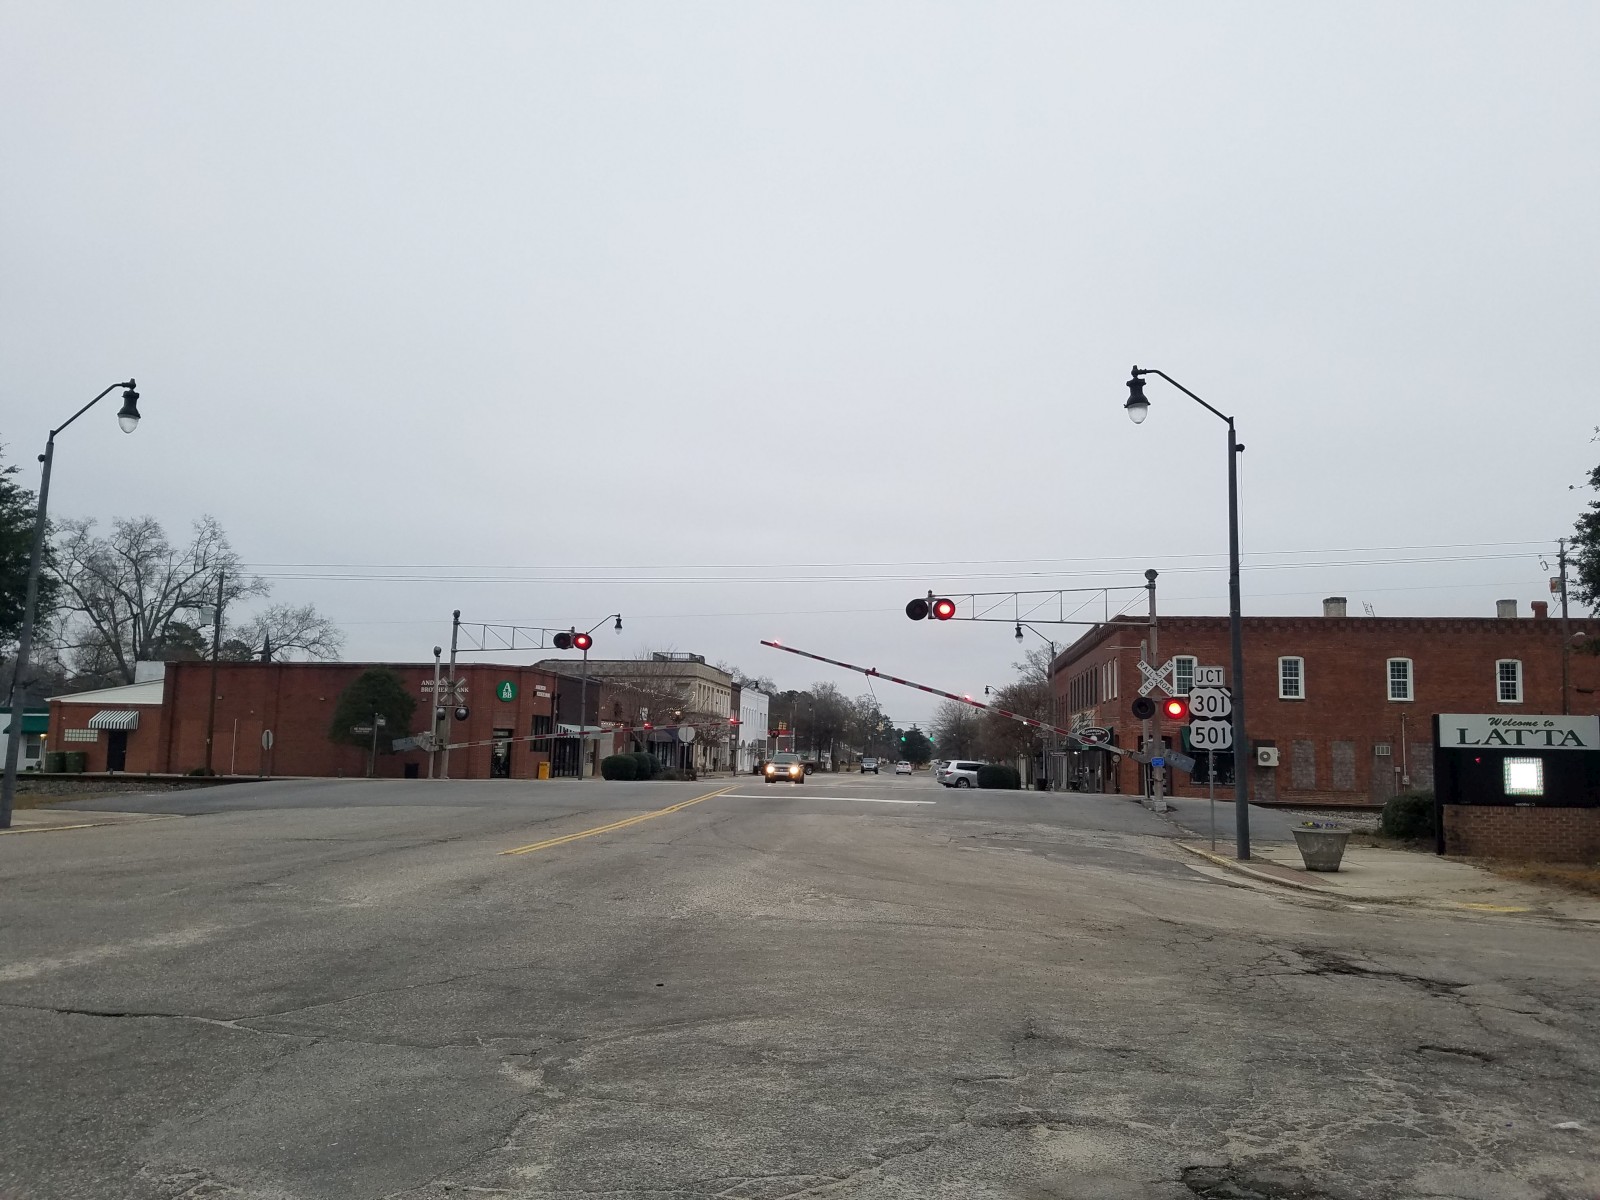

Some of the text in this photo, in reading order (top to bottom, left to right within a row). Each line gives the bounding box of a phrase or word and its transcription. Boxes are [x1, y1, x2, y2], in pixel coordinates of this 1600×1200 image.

[1139, 661, 1173, 695] CROSSING
[1197, 669, 1222, 683] JCT
[502, 682, 512, 692] A
[1194, 695, 1225, 713] 301
[1487, 716, 1555, 727] Welcome to
[1195, 726, 1226, 744] 501
[1456, 728, 1588, 747] LATTA
